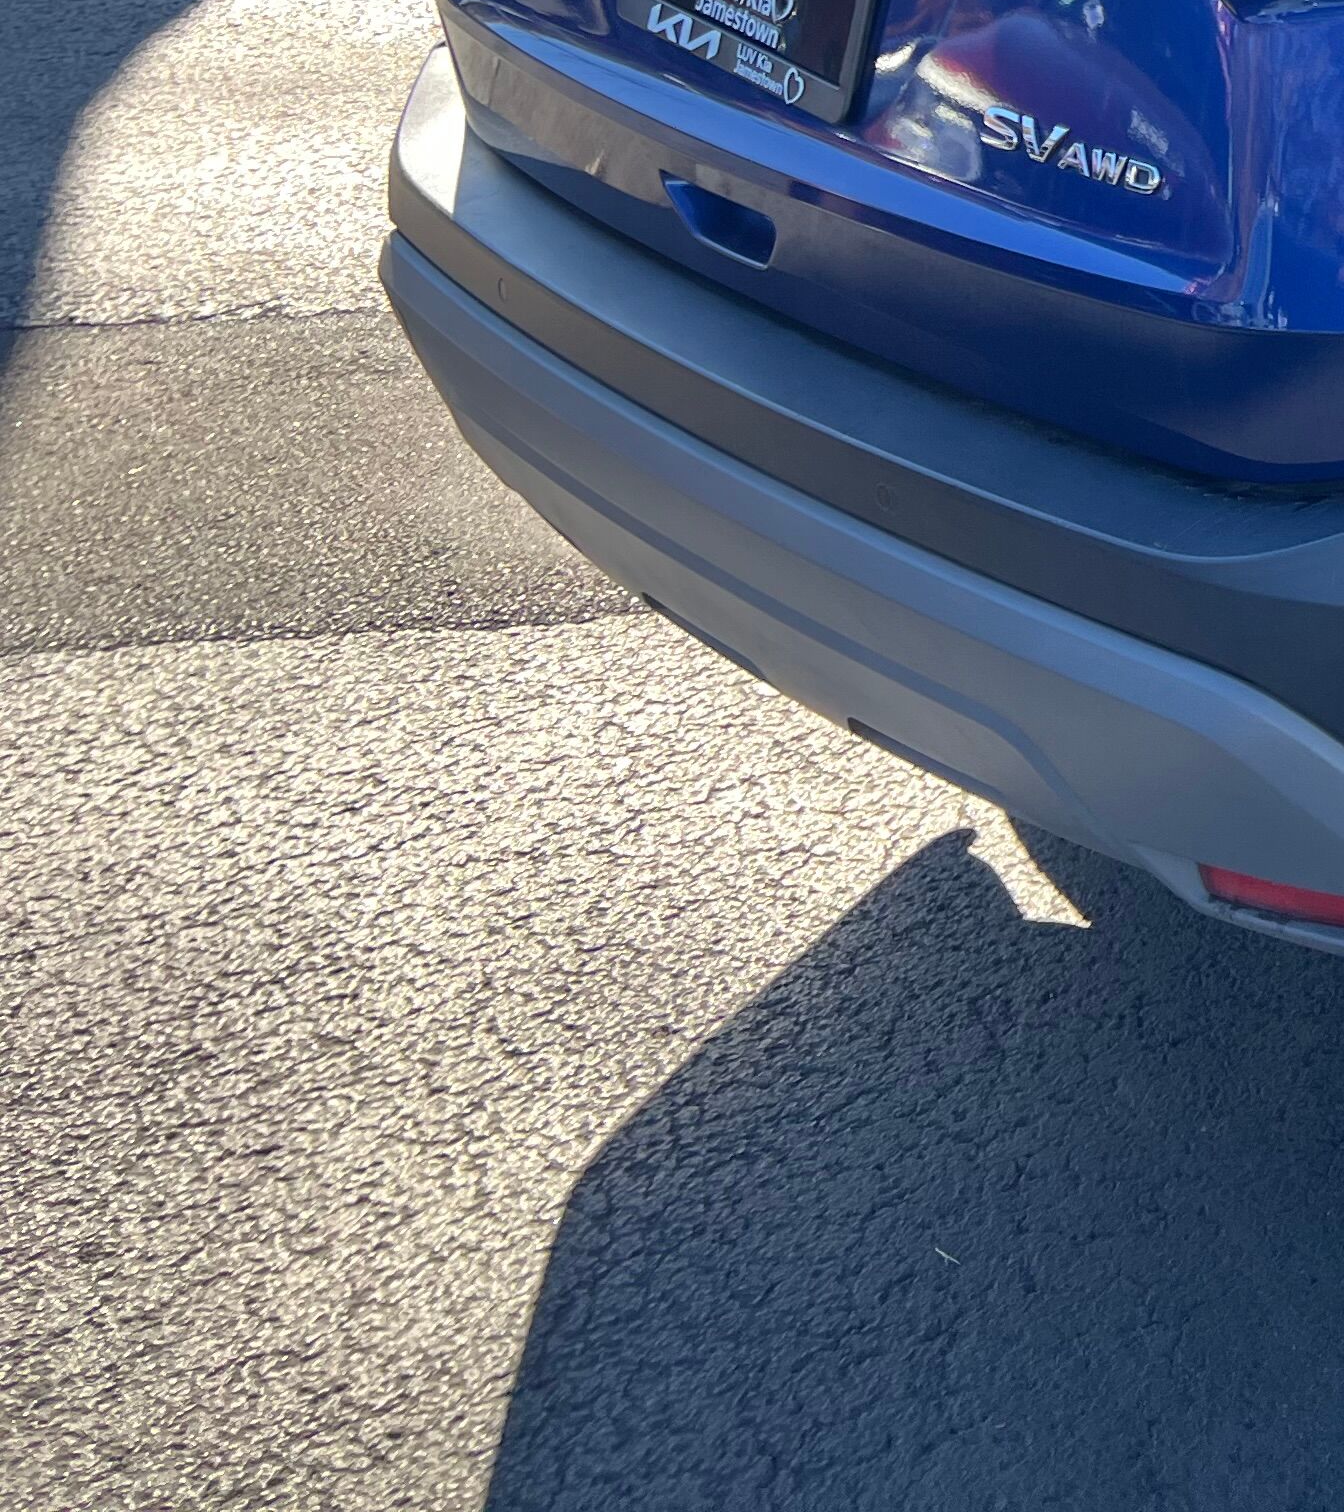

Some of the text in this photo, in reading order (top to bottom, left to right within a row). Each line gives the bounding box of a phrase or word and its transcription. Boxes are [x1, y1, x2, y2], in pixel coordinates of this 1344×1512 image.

[736, 42, 773, 75] LUV Kia
[734, 60, 784, 96] Jamestown
[980, 105, 1162, 196] SV AWD
